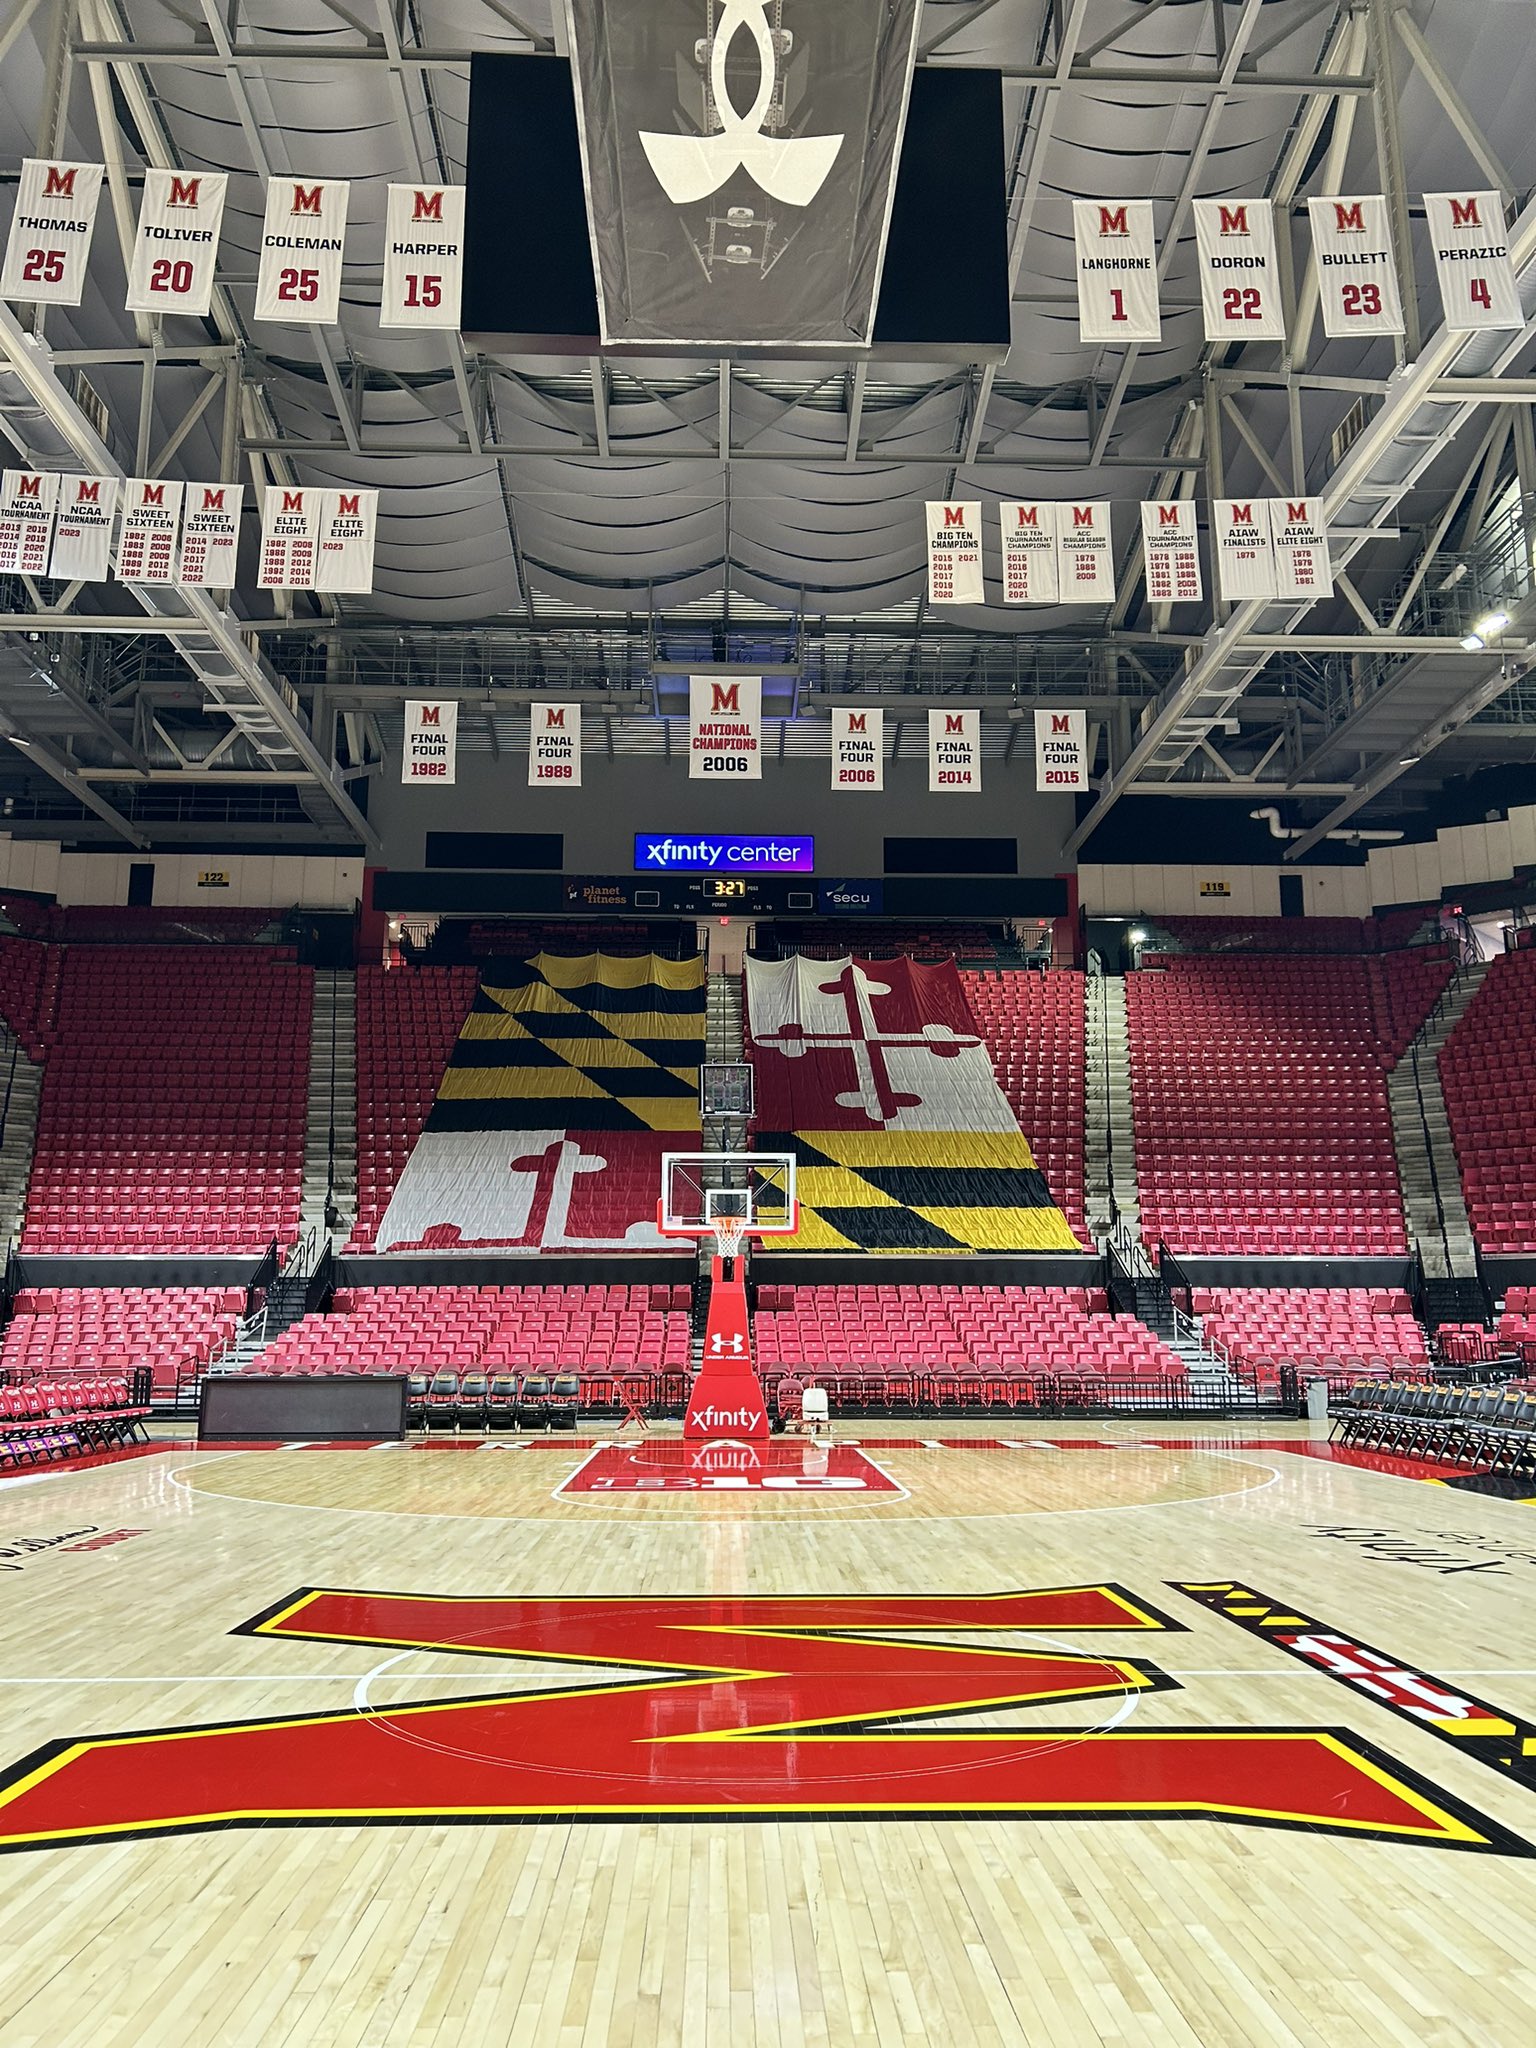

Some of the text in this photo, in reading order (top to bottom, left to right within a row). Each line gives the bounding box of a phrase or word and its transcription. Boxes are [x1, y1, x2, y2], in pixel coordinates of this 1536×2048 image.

[43, 167, 79, 197] M
[167, 176, 202, 206] M
[291, 185, 324, 213] M
[412, 192, 444, 220] M
[1448, 198, 1482, 226] M
[1099, 206, 1130, 233] M
[1218, 206, 1250, 233] M
[1333, 203, 1365, 230] M
[19, 217, 87, 233] THOMAS
[144, 226, 213, 242] TOLIVER
[265, 235, 342, 250] COLEMAN
[393, 242, 458, 256] HARPER
[1322, 252, 1388, 265] BULLETT
[1439, 246, 1506, 261] PERAZIC
[23, 249, 66, 282] 25
[1082, 257, 1151, 270] LANGHORNE
[1211, 256, 1266, 268] DORON
[150, 260, 194, 293] 20
[278, 269, 319, 301] 25
[404, 275, 441, 307] 15
[1342, 284, 1382, 316] 23
[1470, 279, 1491, 309] 4
[1111, 289, 1127, 320] 1
[1223, 288, 1262, 320] 22
[18, 476, 42, 497] M
[78, 480, 101, 501] M
[143, 484, 166, 504] M
[202, 489, 226, 509] M
[11, 501, 42, 511] NCAA
[282, 491, 304, 511] M
[338, 494, 361, 514] M
[0, 508, 50, 520] TOURNAMENT
[70, 506, 102, 516] NCAA
[132, 509, 170, 519] SWEET
[944, 507, 964, 525] M
[1017, 507, 1038, 525] M
[1072, 507, 1093, 525] M
[1159, 506, 1179, 524] M
[1231, 504, 1253, 523] M
[1286, 502, 1308, 522] M
[59, 514, 111, 526] TOURNAMENT
[126, 519, 174, 529] SIXTEEN
[193, 514, 231, 524] SWEET
[276, 517, 307, 526] ELITE
[333, 520, 364, 528] ELITE
[187, 523, 235, 533] SIXTEEN
[274, 526, 308, 535] EIGHT
[330, 528, 364, 537] EIGHT
[1229, 529, 1259, 537] AIAW
[1284, 527, 1314, 536] AIAW
[186, 537, 233, 546] 2014 2023
[937, 532, 973, 540] BIG TEN
[1223, 538, 1266, 546] FINALISTS
[1277, 536, 1324, 545] ELITE EIGHT
[322, 542, 344, 550] 2023
[931, 540, 979, 549] CHAMPIONS
[184, 555, 205, 564] 2017
[291, 559, 312, 567] 2012
[958, 554, 978, 562] 2021
[183, 564, 204, 573] 2021
[290, 568, 311, 576] 2014
[182, 574, 203, 582] 2022
[933, 572, 953, 580] 2017
[1008, 572, 1028, 580] 2017
[1008, 590, 1028, 598] 2021
[711, 683, 740, 712] M
[421, 706, 441, 725] M
[546, 708, 565, 728] M
[849, 713, 867, 732] M
[945, 715, 964, 733] M
[1052, 715, 1070, 733] M
[699, 723, 752, 737] NATIONAL
[410, 733, 449, 744] FINAL
[537, 736, 574, 746] FINAL
[692, 737, 757, 750] CHAMPIONS
[412, 745, 446, 756] FOUR
[839, 740, 876, 751] FINAL
[936, 742, 973, 752] FINAL
[1043, 742, 1080, 752] FINAL
[538, 747, 572, 758] FOUR
[840, 753, 874, 763] FOUR
[938, 754, 971, 764] FOUR
[1045, 754, 1078, 764] FOUR
[410, 762, 447, 776] 1982
[703, 757, 748, 772] 2006
[537, 765, 573, 779] 1989
[838, 769, 875, 783] 2006
[938, 771, 972, 784] 2014
[1045, 771, 1080, 784] 2015
[647, 839, 801, 866] xfinity center
[204, 872, 224, 881] 122
[583, 886, 620, 898] planet
[714, 881, 744, 895] 3:27
[587, 894, 627, 904] fitness
[833, 893, 870, 903] secu
[691, 1405, 762, 1432] xfinity
